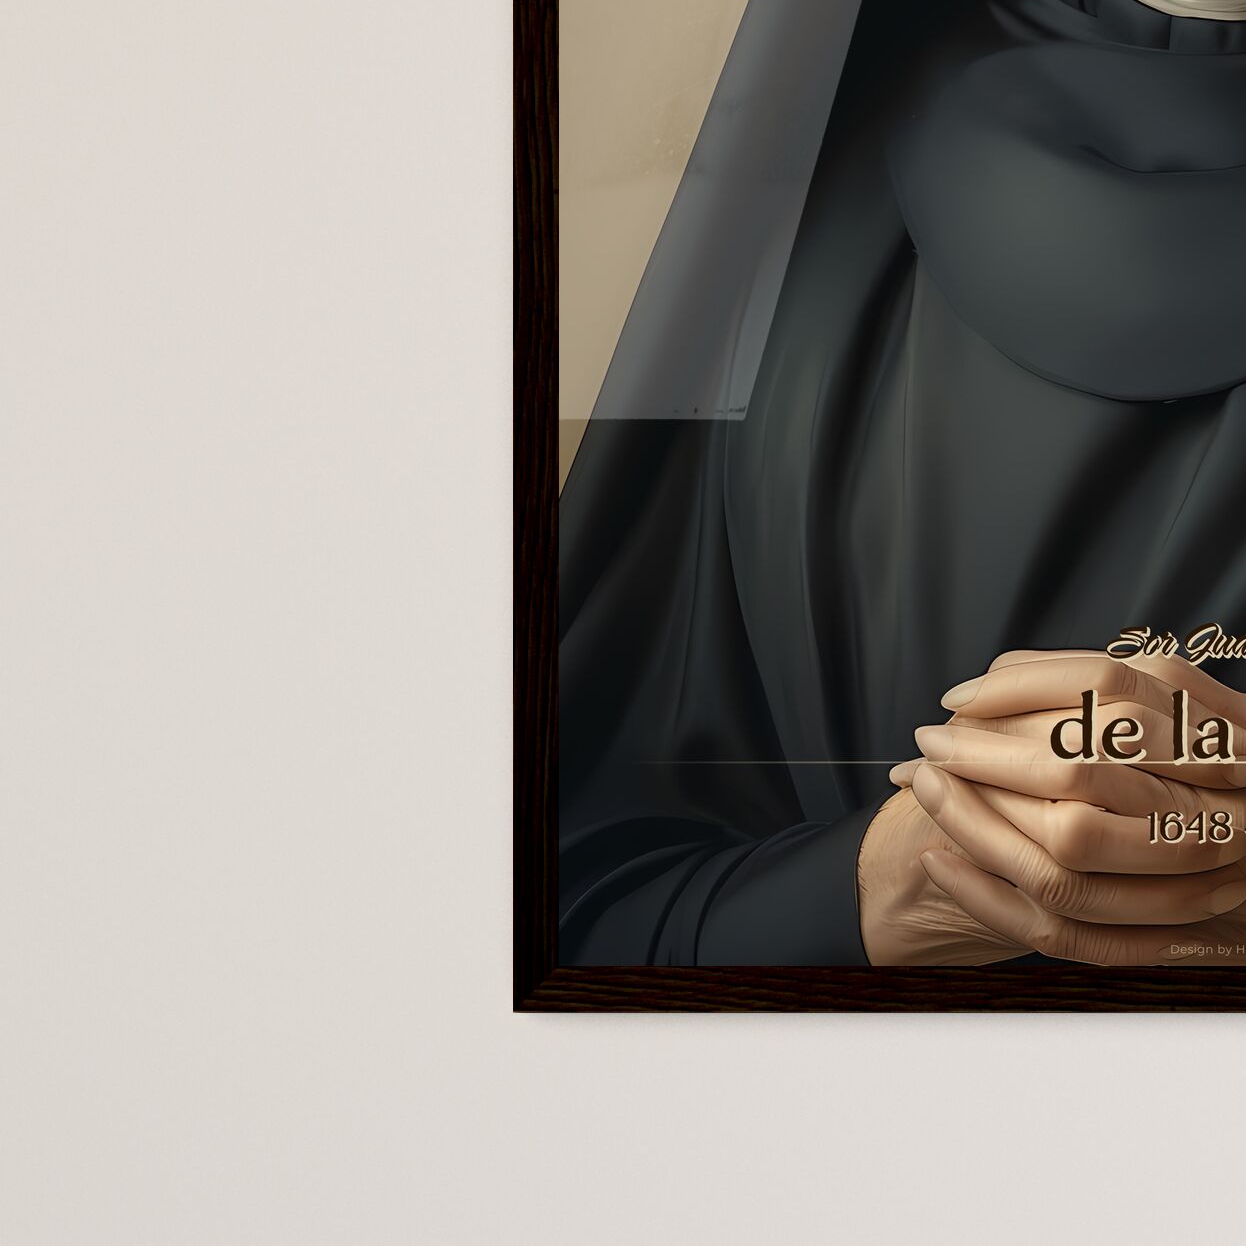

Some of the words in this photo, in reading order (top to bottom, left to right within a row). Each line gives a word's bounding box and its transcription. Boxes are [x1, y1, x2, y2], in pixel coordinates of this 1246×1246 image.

[1106, 626, 1180, 662] Sor
[1050, 689, 1148, 766] de
[1171, 689, 1236, 766] la
[1147, 810, 1235, 844] 1648
[1170, 944, 1214, 957] Design
[1217, 944, 1233, 957] by
